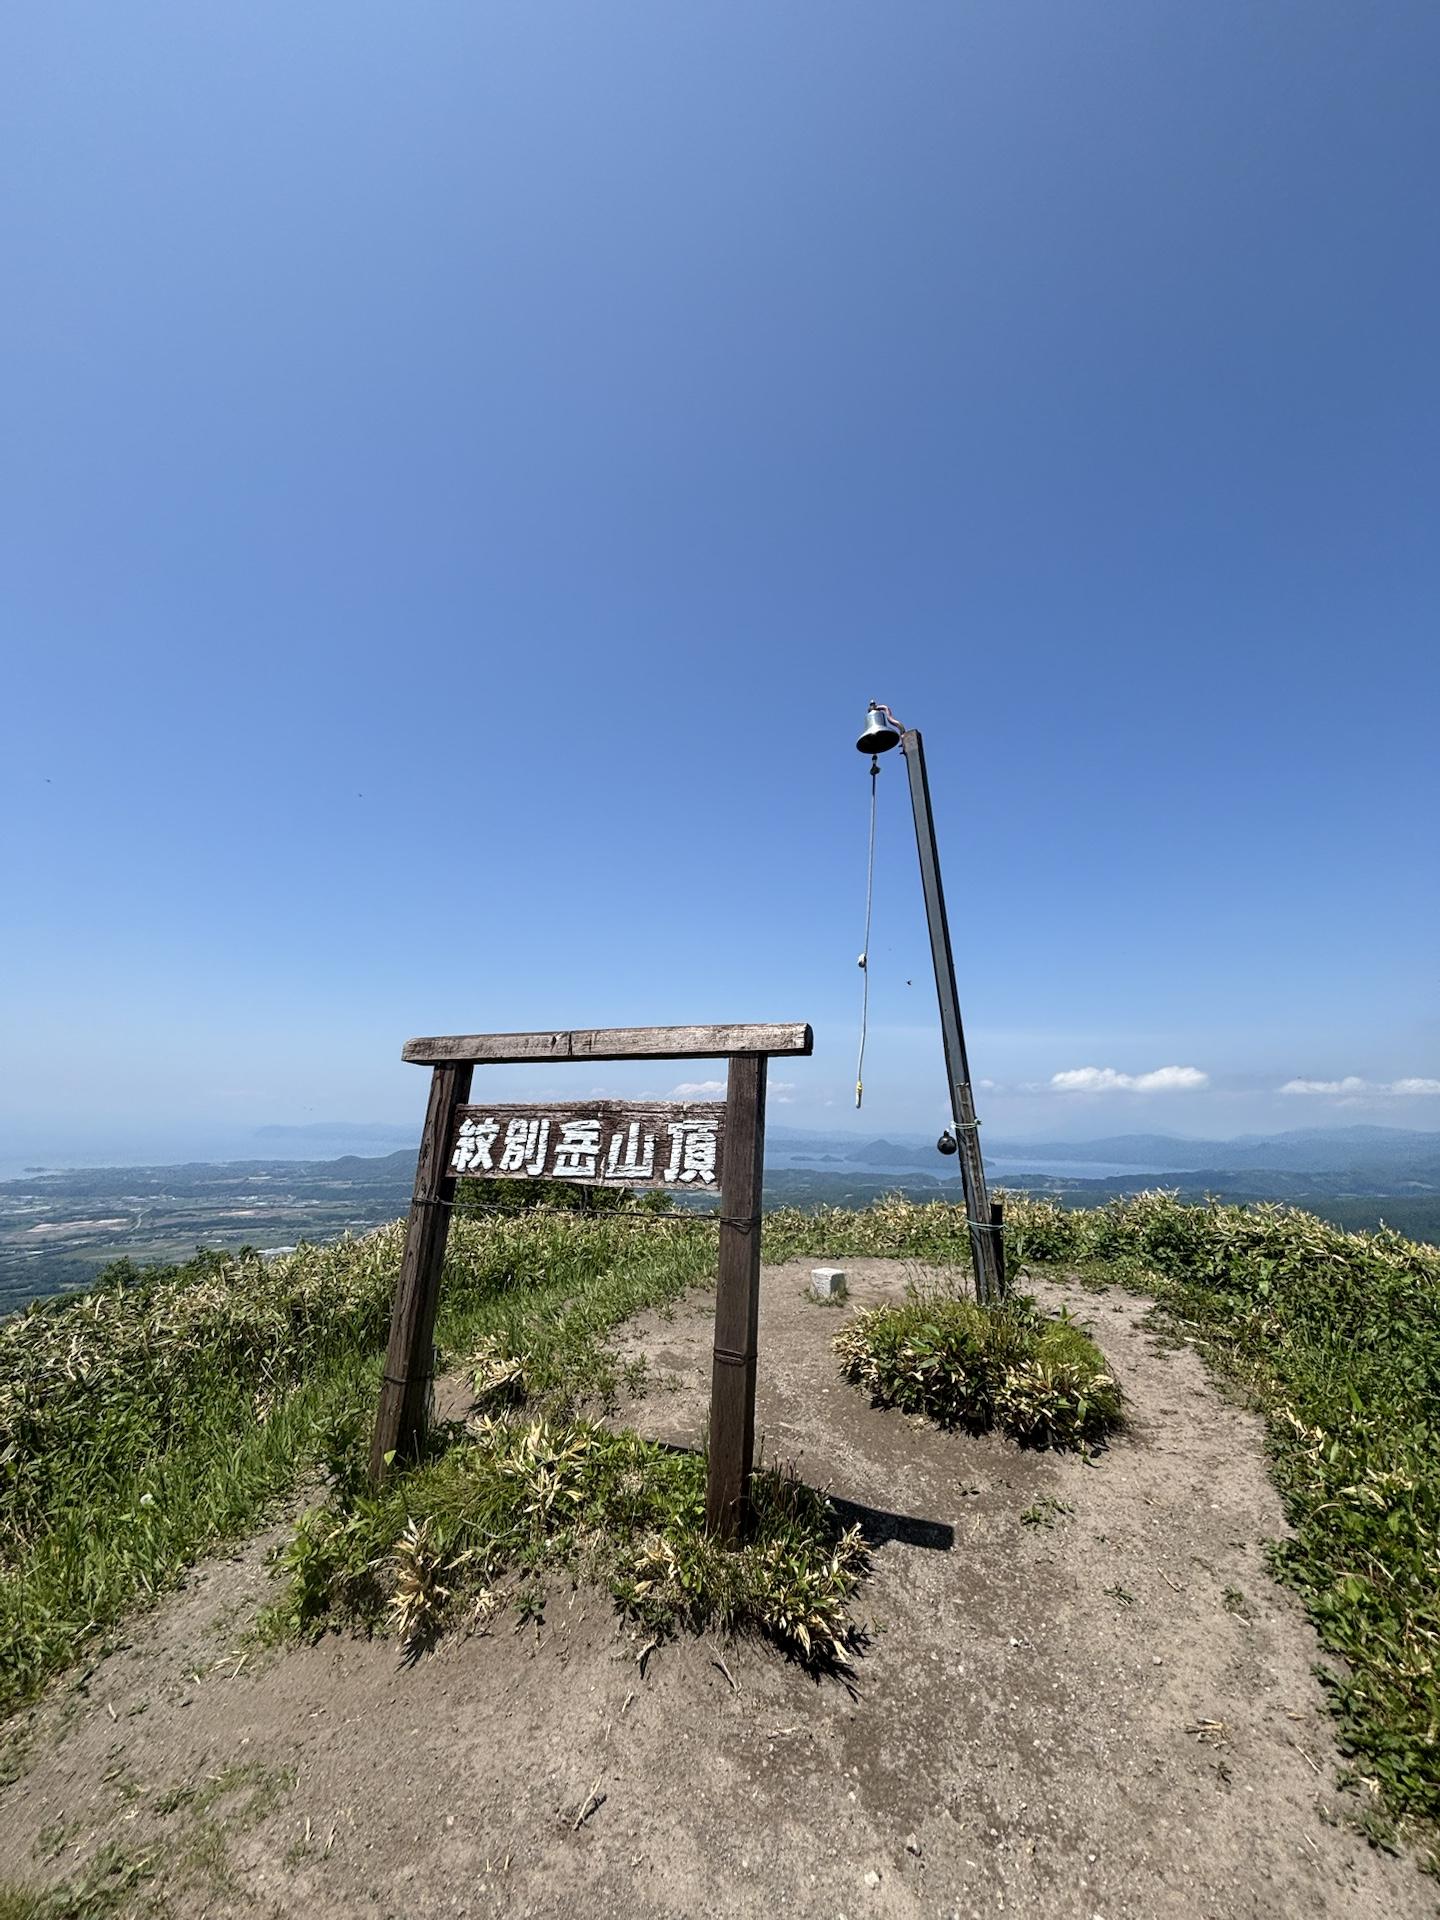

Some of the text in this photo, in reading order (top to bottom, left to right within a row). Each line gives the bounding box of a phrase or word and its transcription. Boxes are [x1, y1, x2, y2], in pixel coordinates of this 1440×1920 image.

[451, 1117, 719, 1184] 紋別岳山頂
